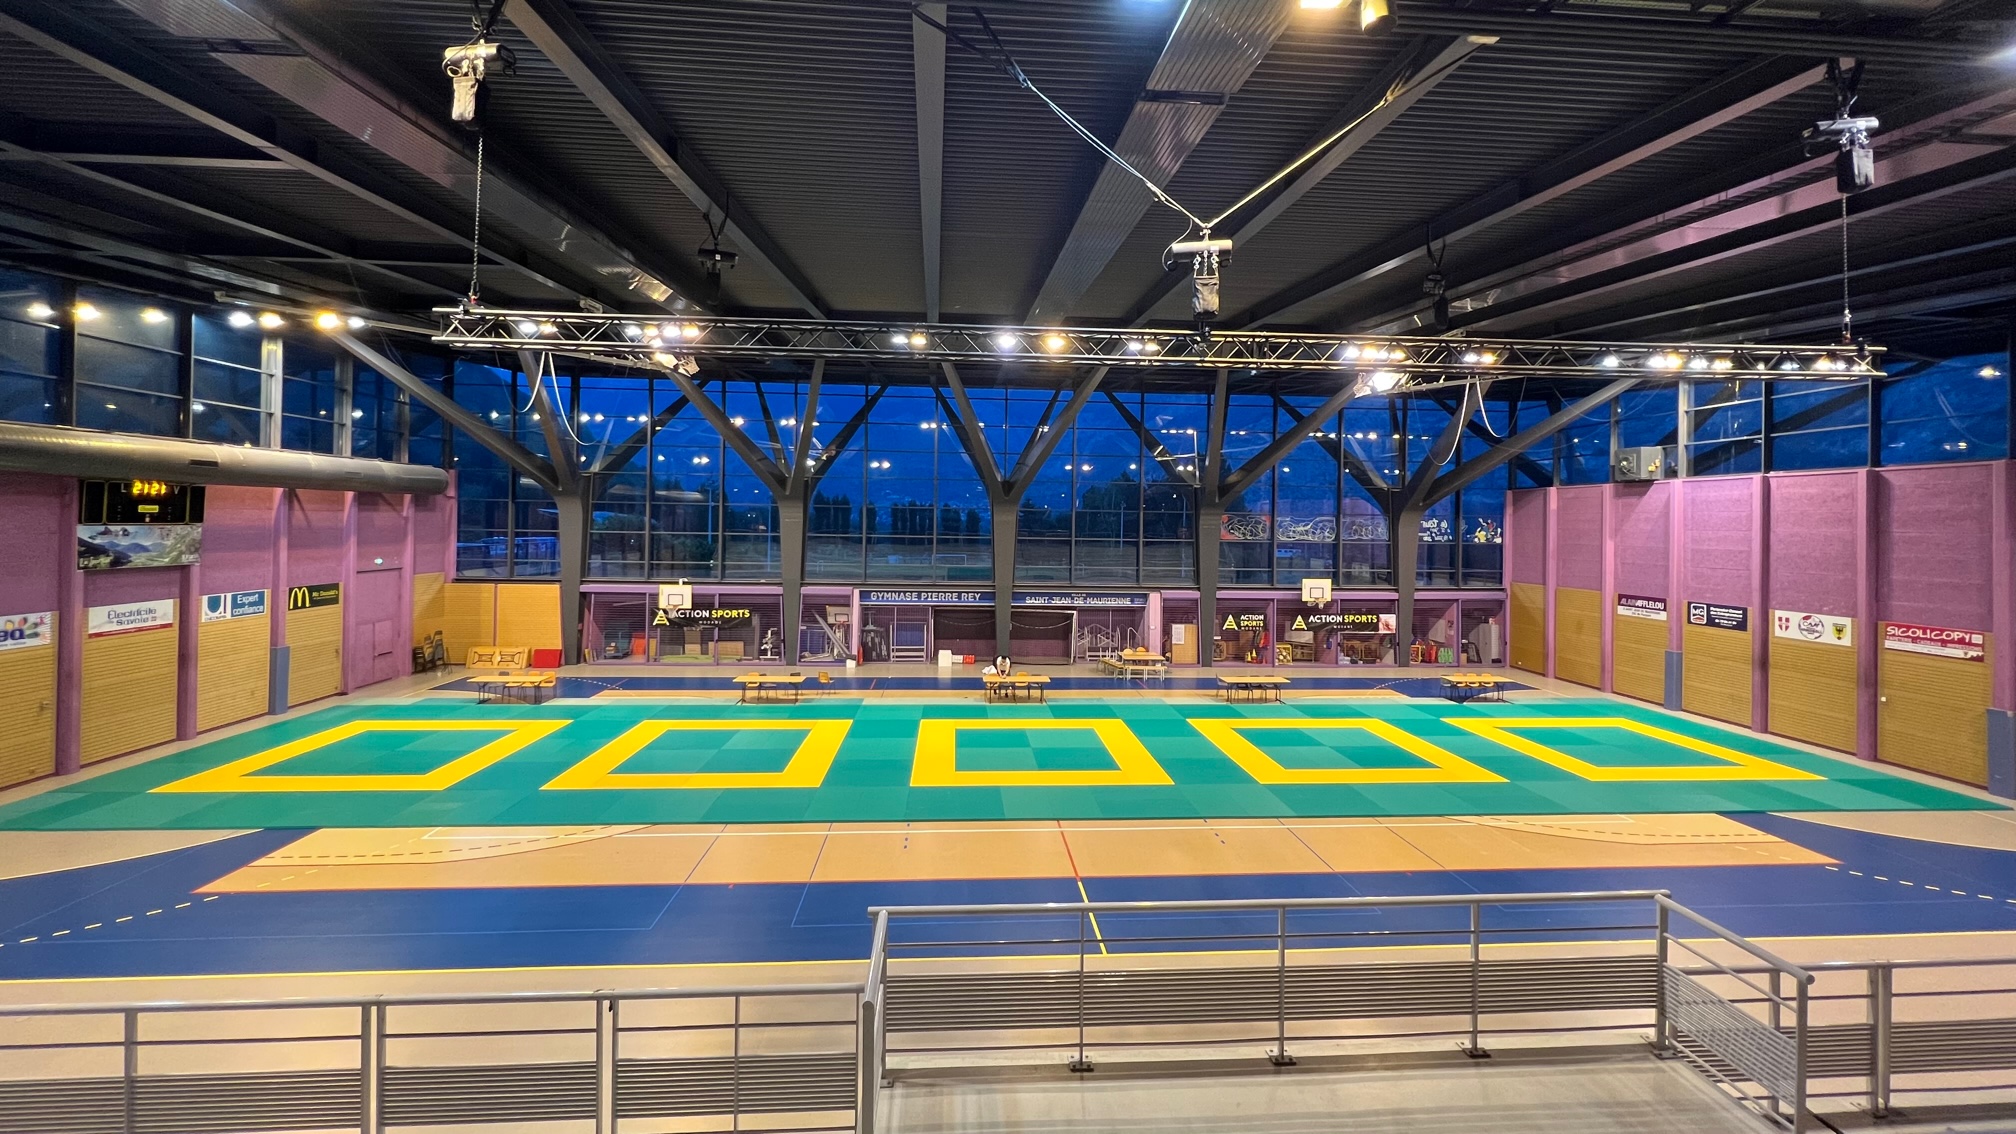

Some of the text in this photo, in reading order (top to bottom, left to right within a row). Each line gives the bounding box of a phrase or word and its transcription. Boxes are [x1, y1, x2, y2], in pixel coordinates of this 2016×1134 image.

[237, 594, 259, 604] Expert
[870, 591, 981, 602] GYMNASE PIERRE REY
[1025, 596, 1131, 605] SAINT-JEAN-DE-MAURIENNE
[232, 605, 264, 616] confiance
[711, 609, 750, 618] SPORTS
[1308, 614, 1377, 623] ACTION SPORTS
[1886, 626, 1970, 643] SICOLICOPY
